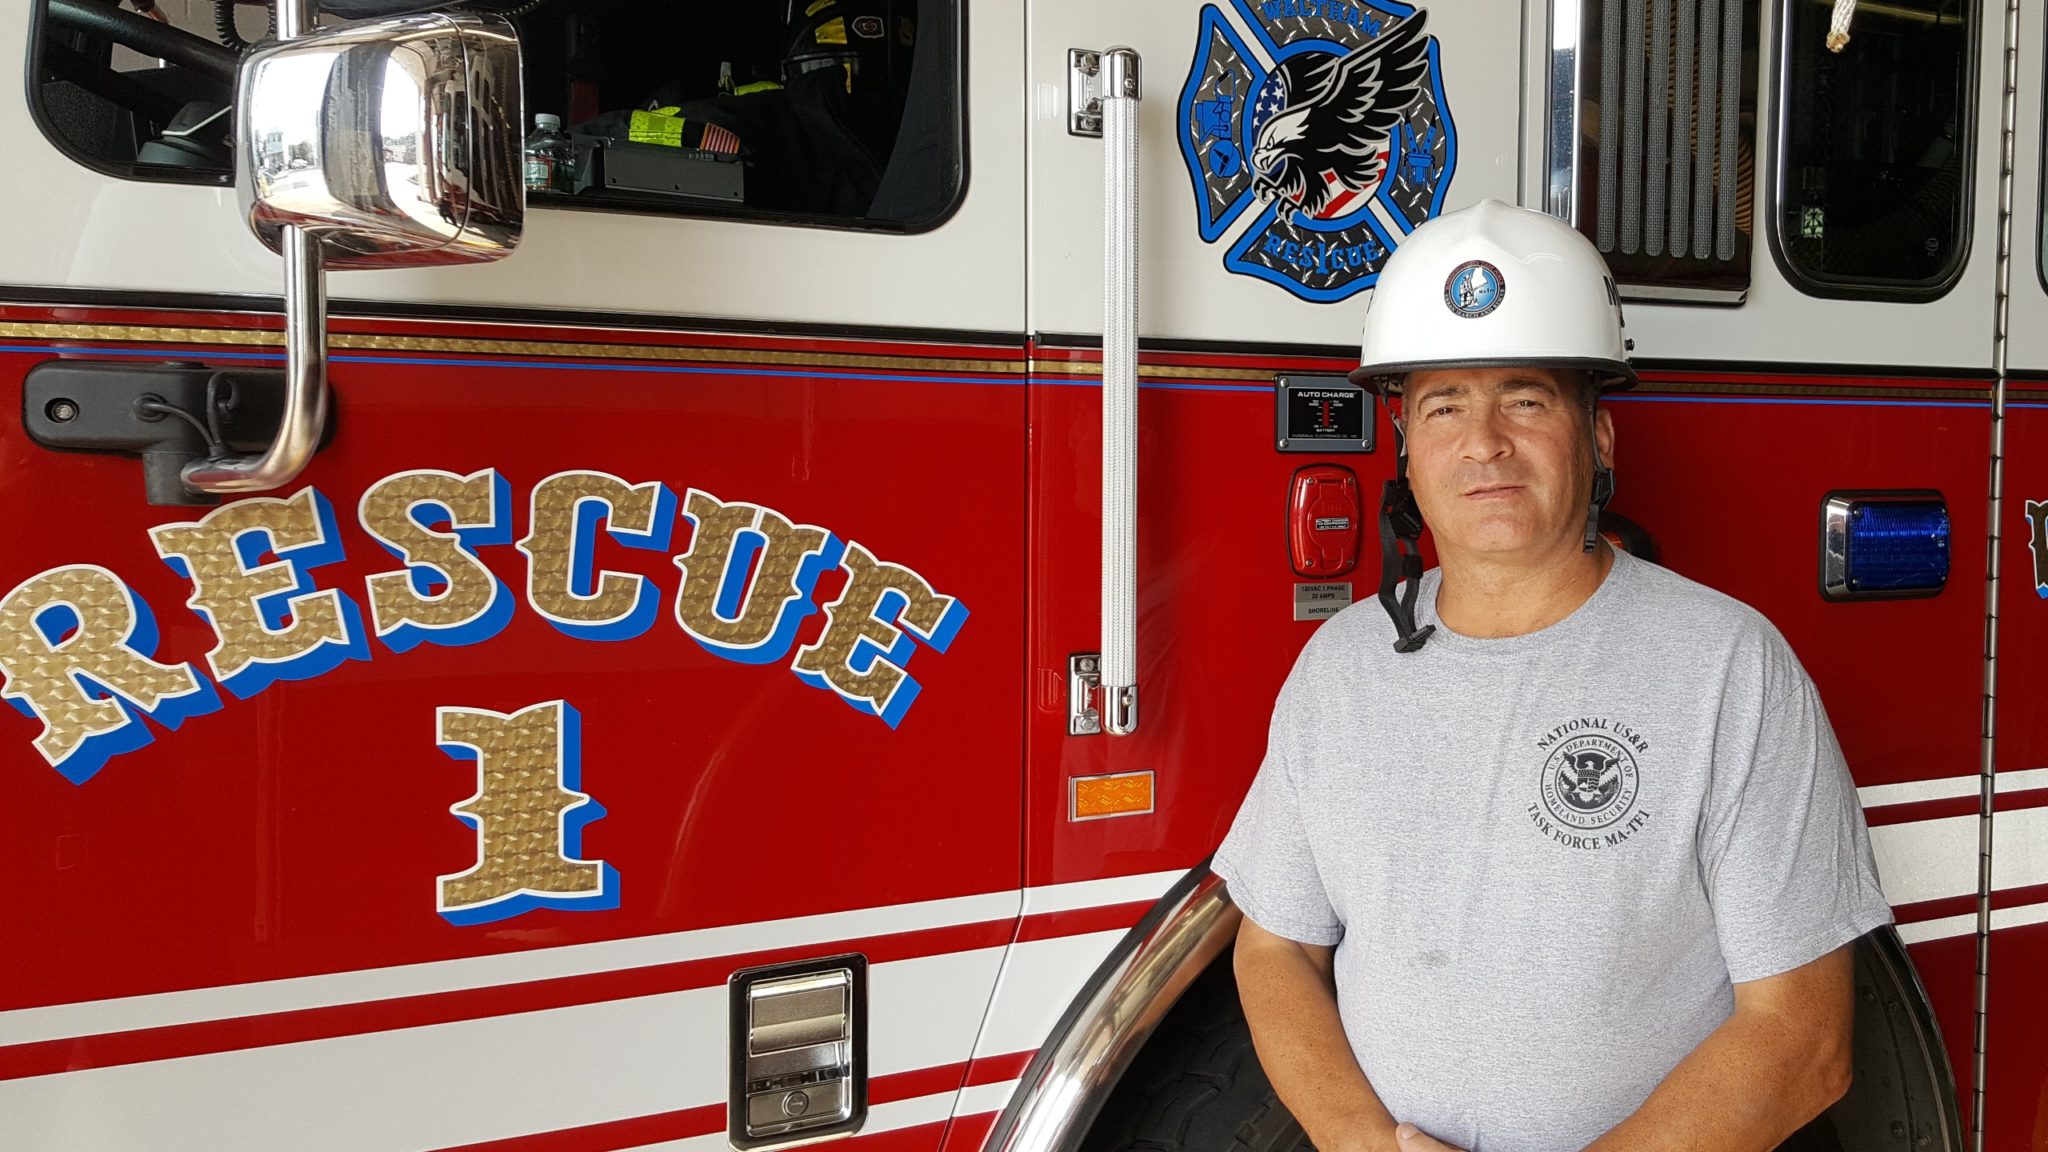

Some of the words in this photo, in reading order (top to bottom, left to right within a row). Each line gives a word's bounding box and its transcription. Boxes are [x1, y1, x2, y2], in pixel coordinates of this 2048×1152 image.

[1262, 0, 1382, 38] WALTHAM
[1321, 391, 1355, 399] CHARGE
[0, 467, 968, 784] RESCUE
[1307, 606, 1340, 614] SHORELINE
[1537, 717, 1608, 751] NATIONAL
[1613, 721, 1649, 753] US&R
[1565, 738, 1628, 763] DEPARTMENT
[1624, 765, 1634, 778] OF
[434, 699, 620, 925] 1
[1544, 783, 1586, 825] HOMELAND
[1590, 788, 1633, 825] SECURITY
[1527, 802, 1553, 836] TASK
[1553, 829, 1601, 850] FORCE
[1604, 808, 1651, 848] MA-TF1
